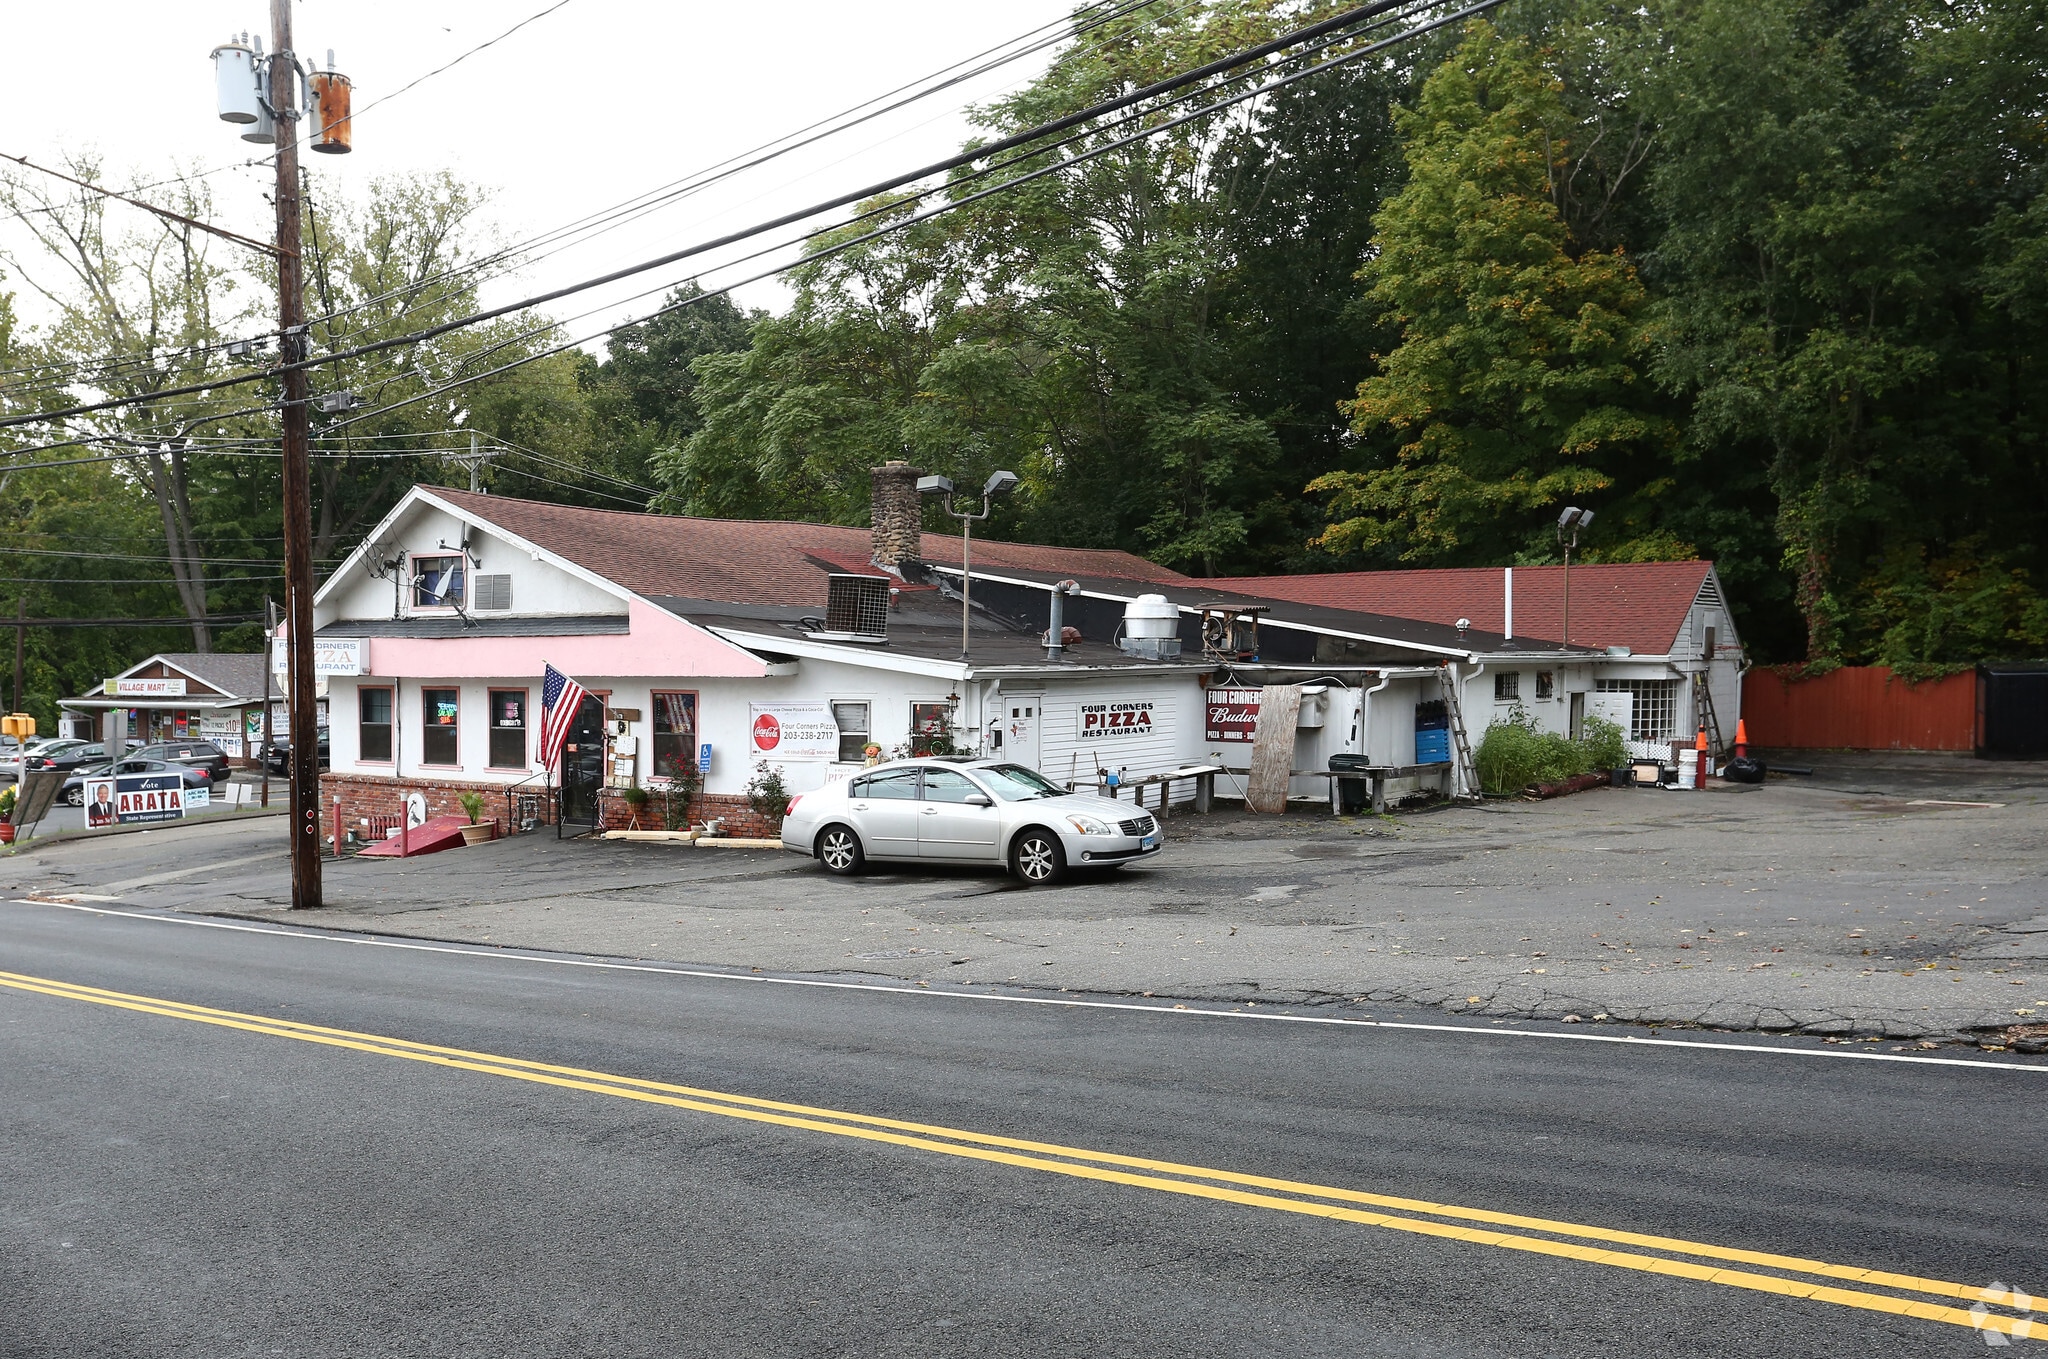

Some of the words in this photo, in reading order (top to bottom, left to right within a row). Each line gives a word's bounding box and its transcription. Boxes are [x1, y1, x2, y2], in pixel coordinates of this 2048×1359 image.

[119, 683, 144, 691] VILLAGE
[147, 683, 166, 691] MART
[1207, 690, 1228, 704] FOUR
[1081, 704, 1107, 713] FOUR
[1110, 702, 1154, 712] CORNERS
[1085, 710, 1152, 729] PIZZA
[754, 726, 779, 738] Coca-Cola
[783, 731, 834, 740] 203-238-2717
[1081, 725, 1153, 738] RESTAURANT
[1207, 730, 1220, 739] PIZZA
[1223, 731, 1243, 740] DINNERS
[120, 791, 181, 812] ARATA
